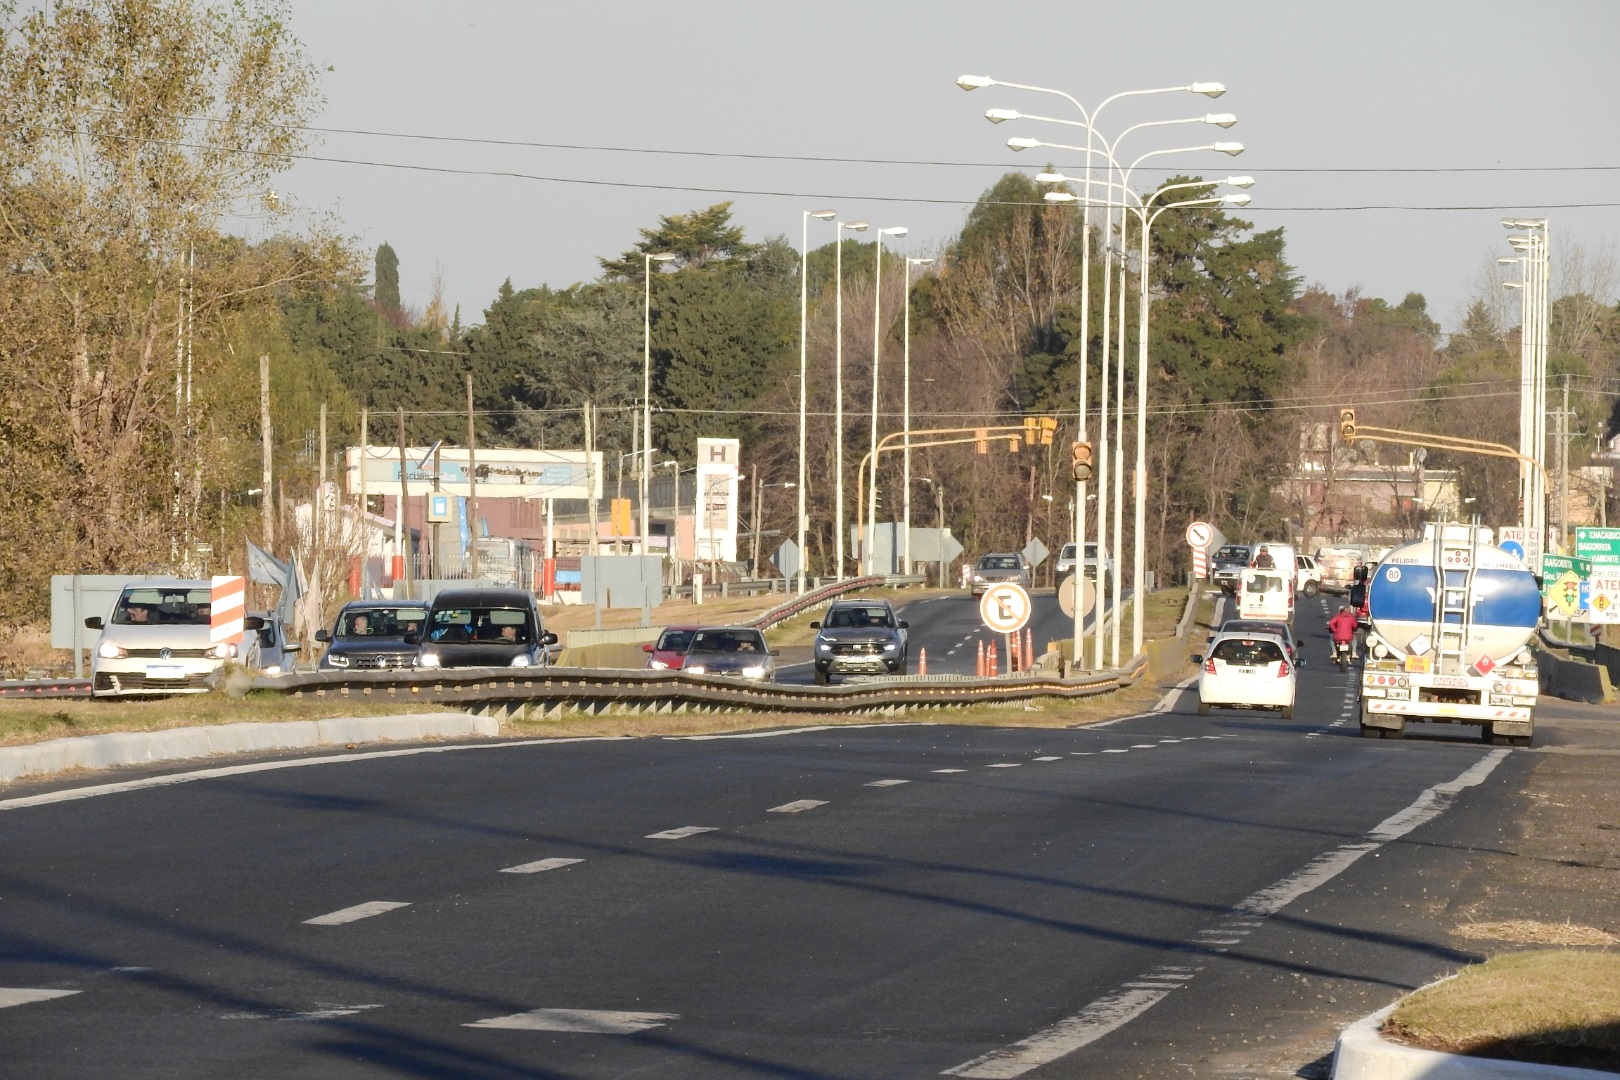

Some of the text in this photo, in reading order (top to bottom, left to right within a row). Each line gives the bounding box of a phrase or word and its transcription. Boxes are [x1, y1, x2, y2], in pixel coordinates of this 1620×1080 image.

[710, 446, 726, 462] H
[1391, 557, 1419, 565] PELIGRO
[1544, 557, 1573, 570] BAIGORRITA
[1388, 570, 1399, 580] 80
